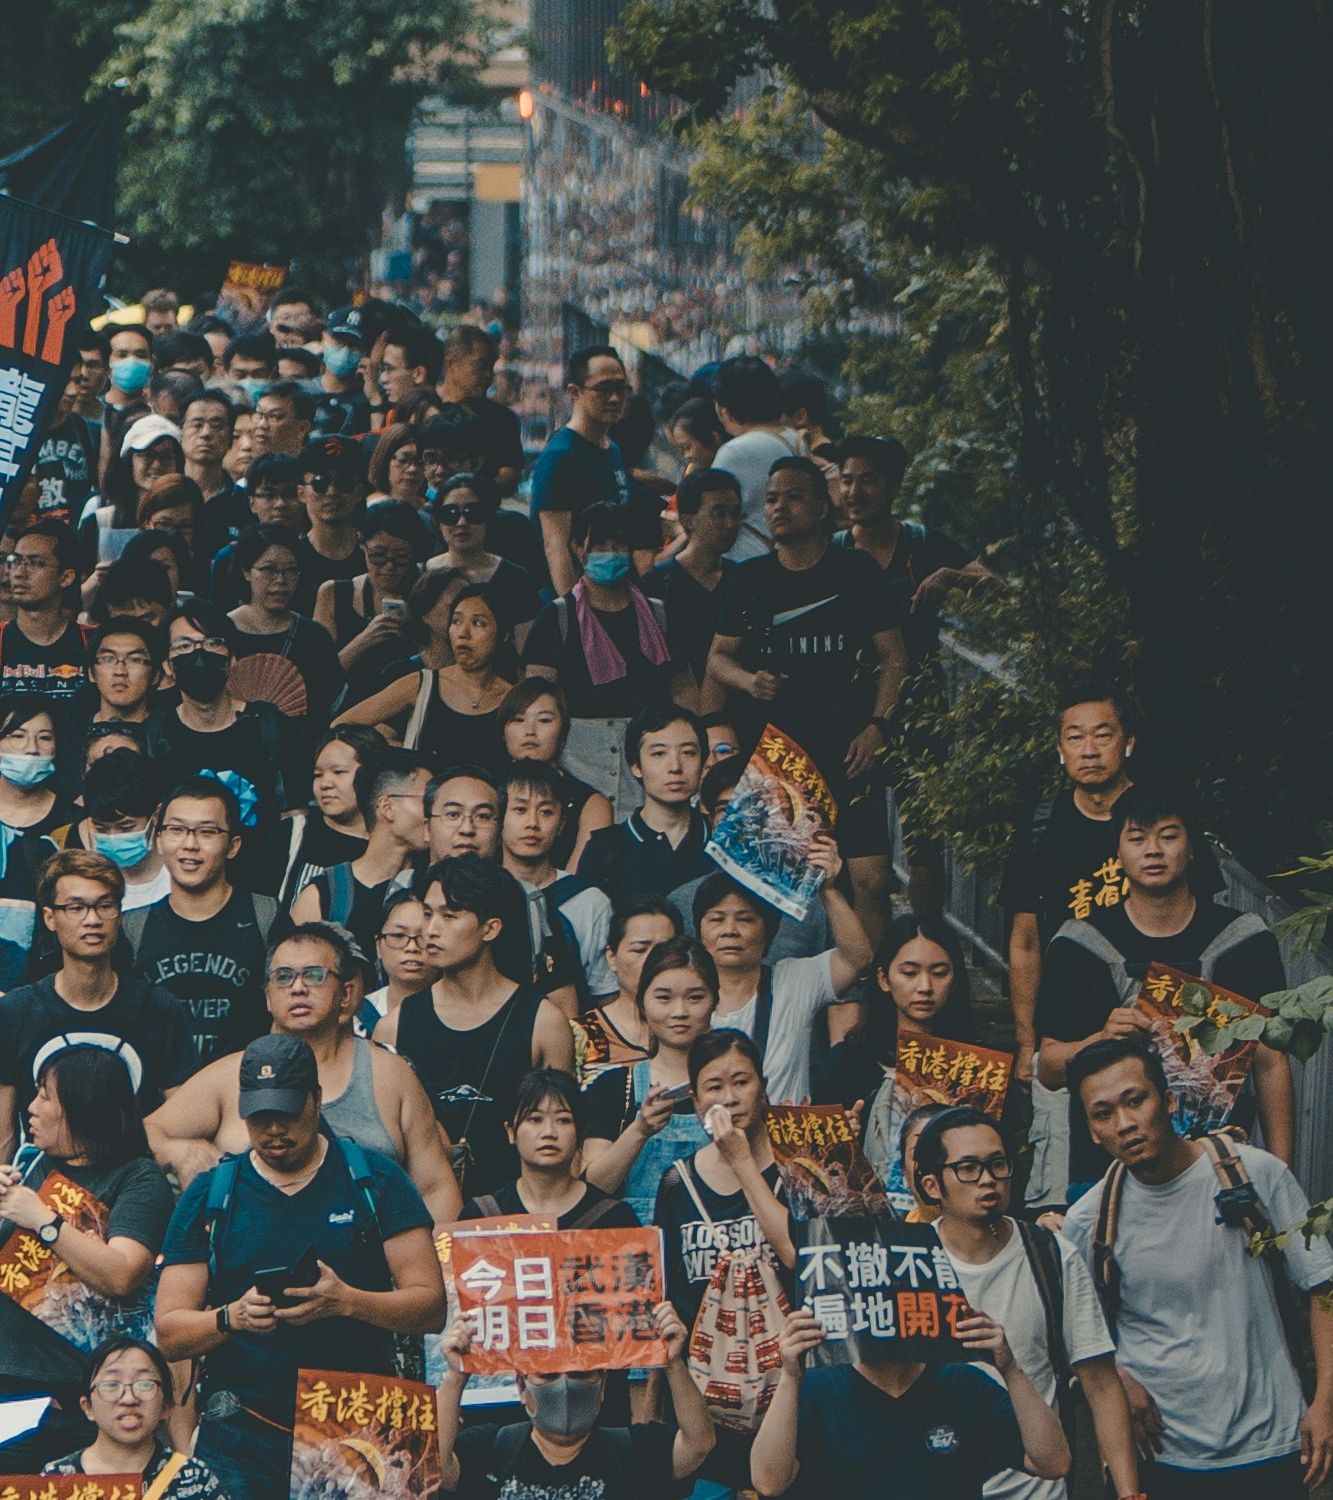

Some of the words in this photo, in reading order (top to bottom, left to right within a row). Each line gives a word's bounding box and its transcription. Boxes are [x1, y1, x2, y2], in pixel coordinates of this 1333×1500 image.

[898, 1040, 1006, 1091] 香港撐住
[766, 1111, 854, 1147] 香港撐住
[799, 1242, 966, 1290] 不撤不散
[299, 1381, 436, 1432] 香港撐住
